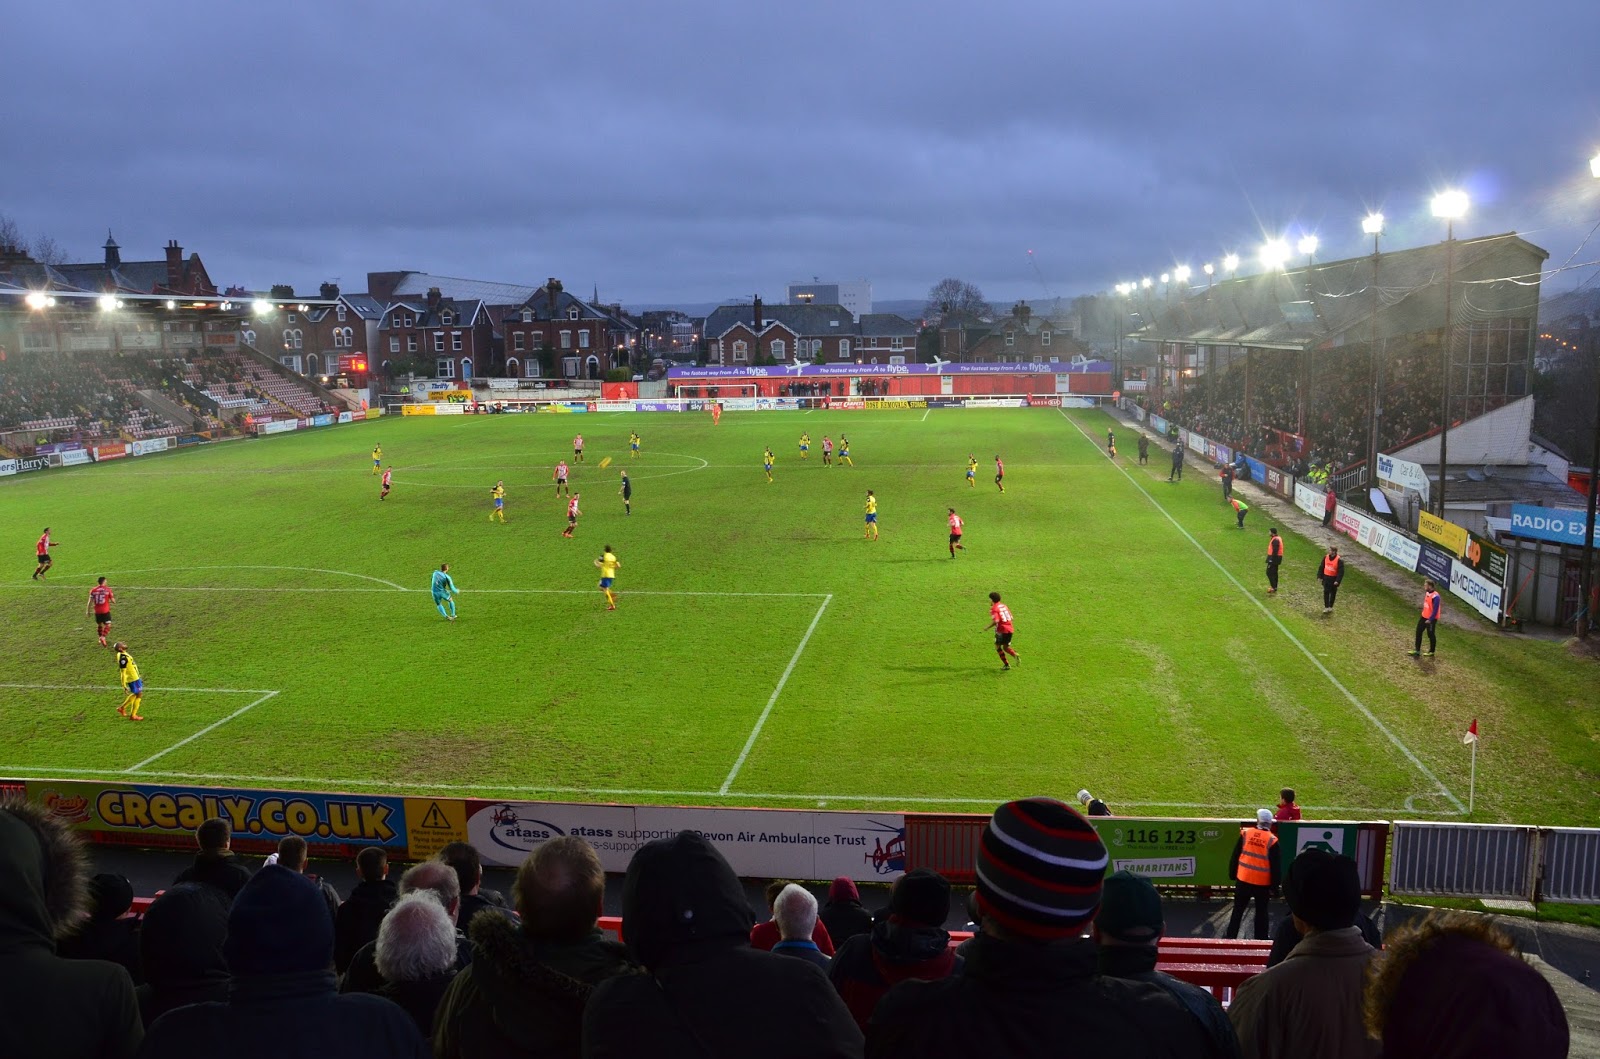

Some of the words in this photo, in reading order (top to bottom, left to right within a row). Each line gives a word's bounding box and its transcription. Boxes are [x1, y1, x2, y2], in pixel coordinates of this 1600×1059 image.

[0, 462, 14, 471] ers
[15, 457, 49, 470] Harry's
[1512, 514, 1564, 532] RADIO
[506, 827, 550, 838] atass
[571, 826, 613, 837] atass
[737, 831, 755, 842] Air
[759, 832, 830, 844] Ambulance
[834, 834, 866, 845] Trust
[1127, 830, 1158, 843] 116
[1165, 830, 1196, 844] 123
[1124, 863, 1188, 872] SAMARITANS
